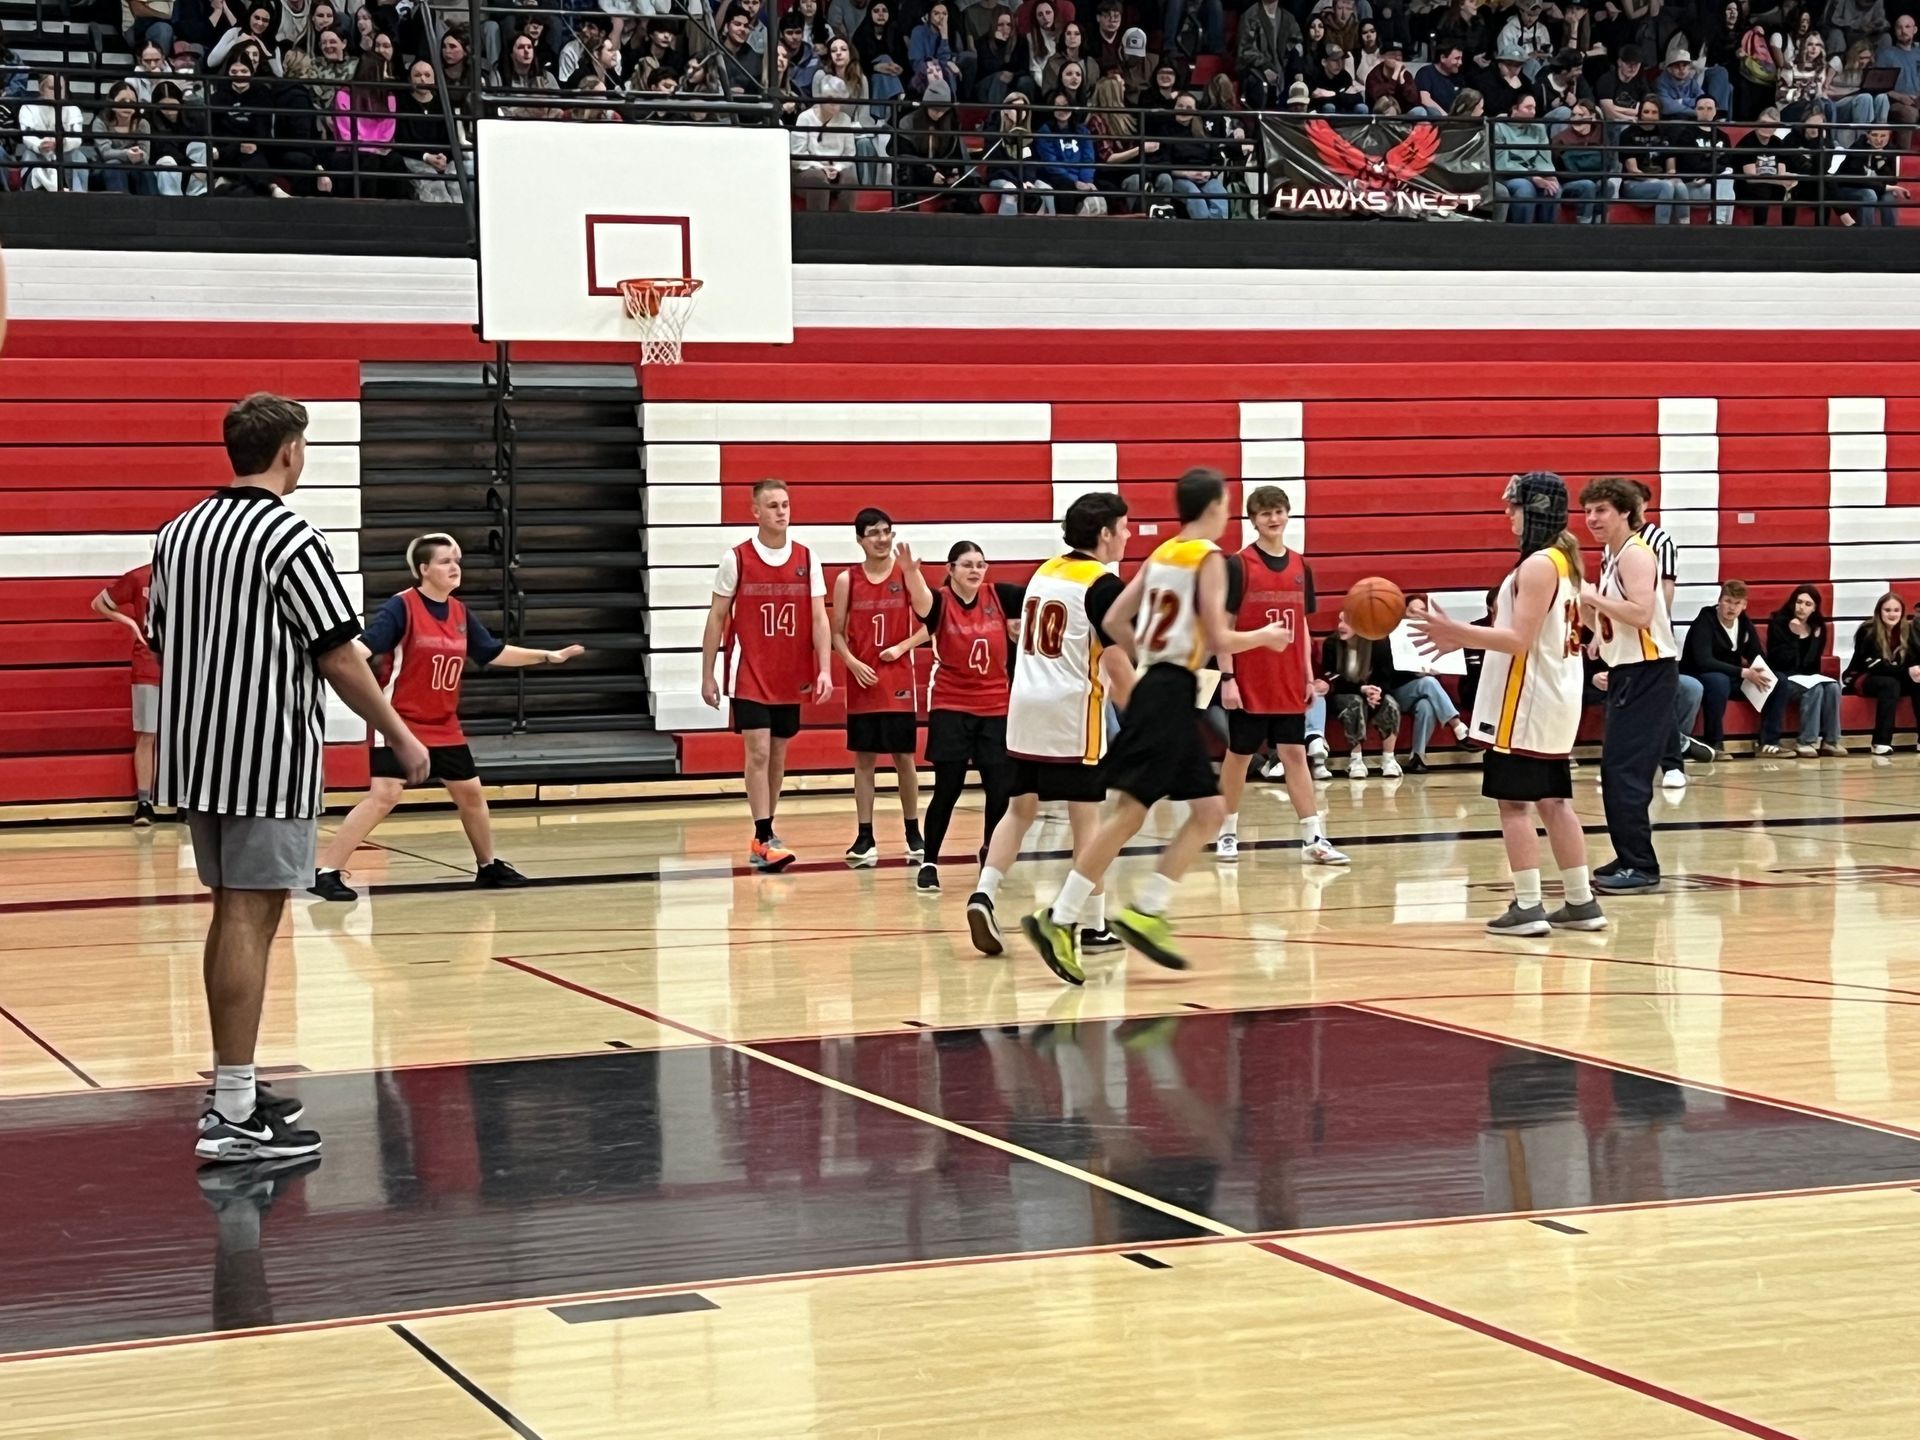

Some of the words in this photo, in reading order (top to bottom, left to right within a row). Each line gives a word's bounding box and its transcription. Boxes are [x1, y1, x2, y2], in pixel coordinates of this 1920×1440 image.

[1275, 188, 1388, 211] HAWKS
[1396, 191, 1481, 211] NEST
[760, 603, 796, 636] 14
[872, 613, 885, 646] 1
[1023, 596, 1068, 659] 10
[431, 654, 464, 691] 10
[969, 638, 990, 675] 4
